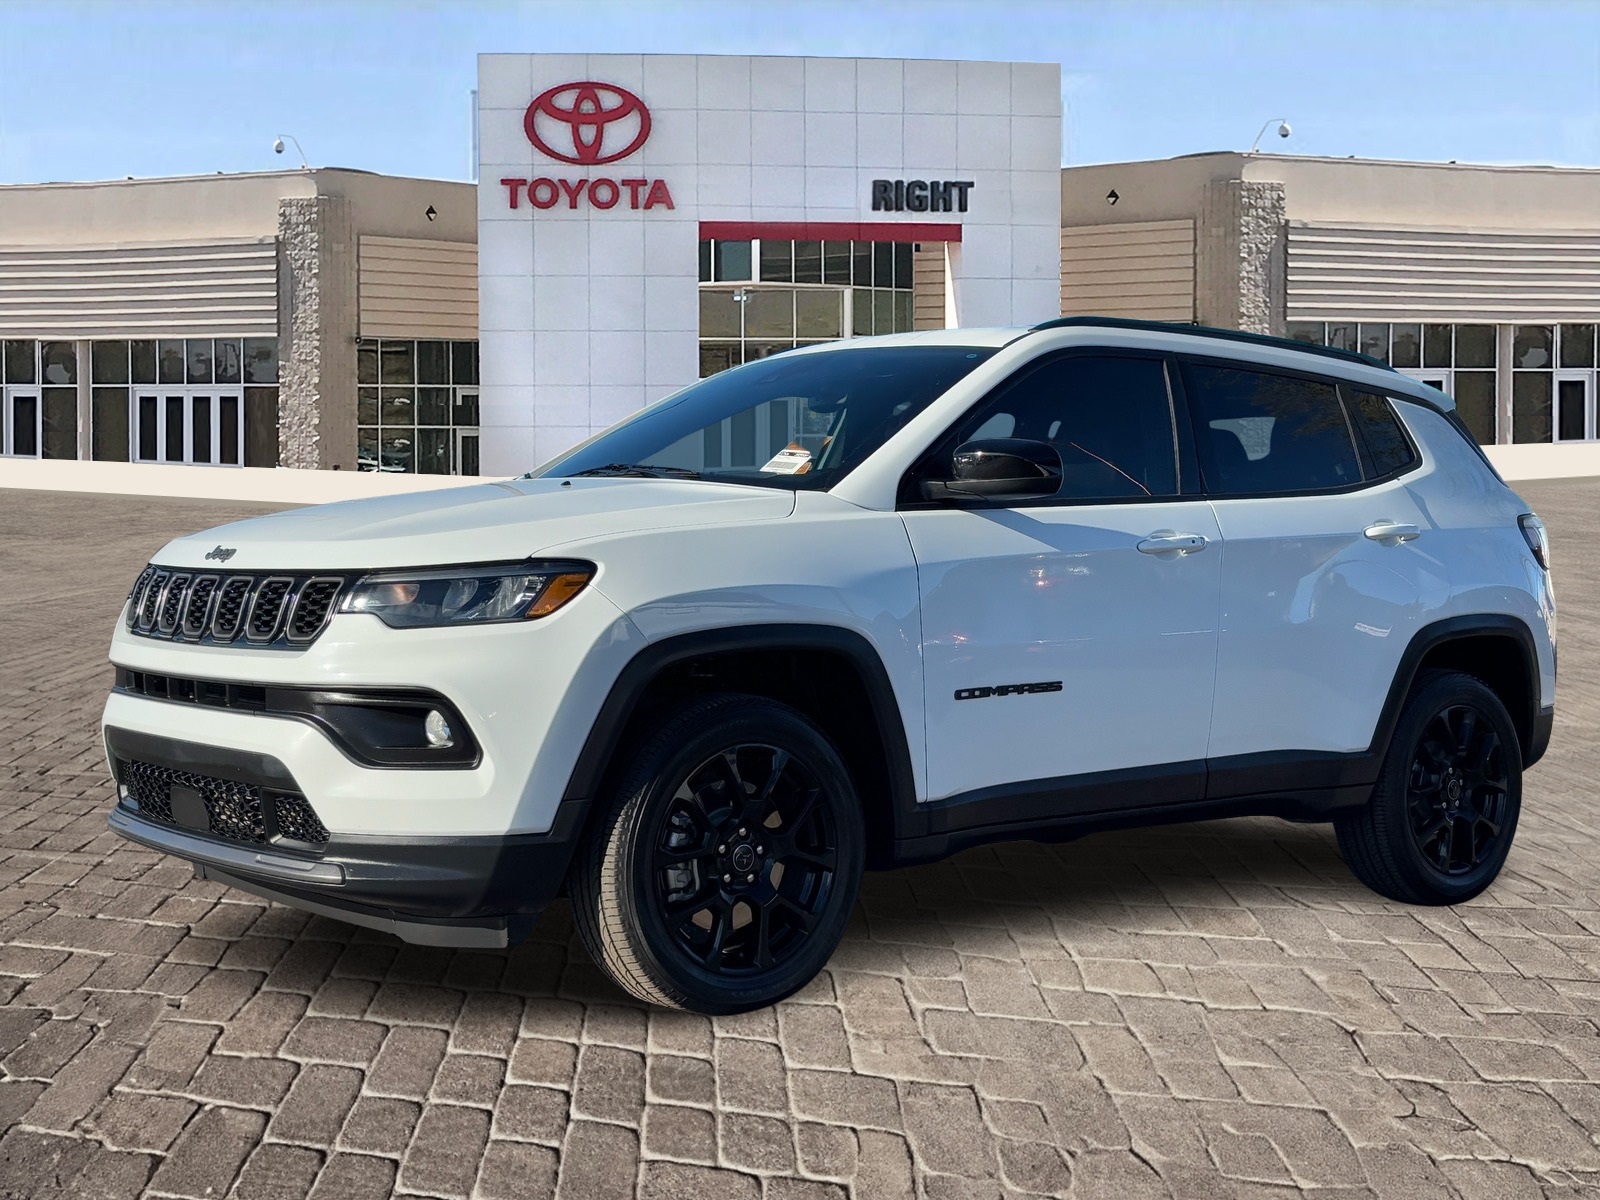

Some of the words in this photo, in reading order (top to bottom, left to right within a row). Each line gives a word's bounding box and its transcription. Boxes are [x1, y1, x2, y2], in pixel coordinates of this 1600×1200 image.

[500, 177, 675, 210] TOYOTA
[872, 179, 975, 212] RIGHT
[205, 545, 237, 563] Jeep
[954, 681, 1063, 700] COMPASS
